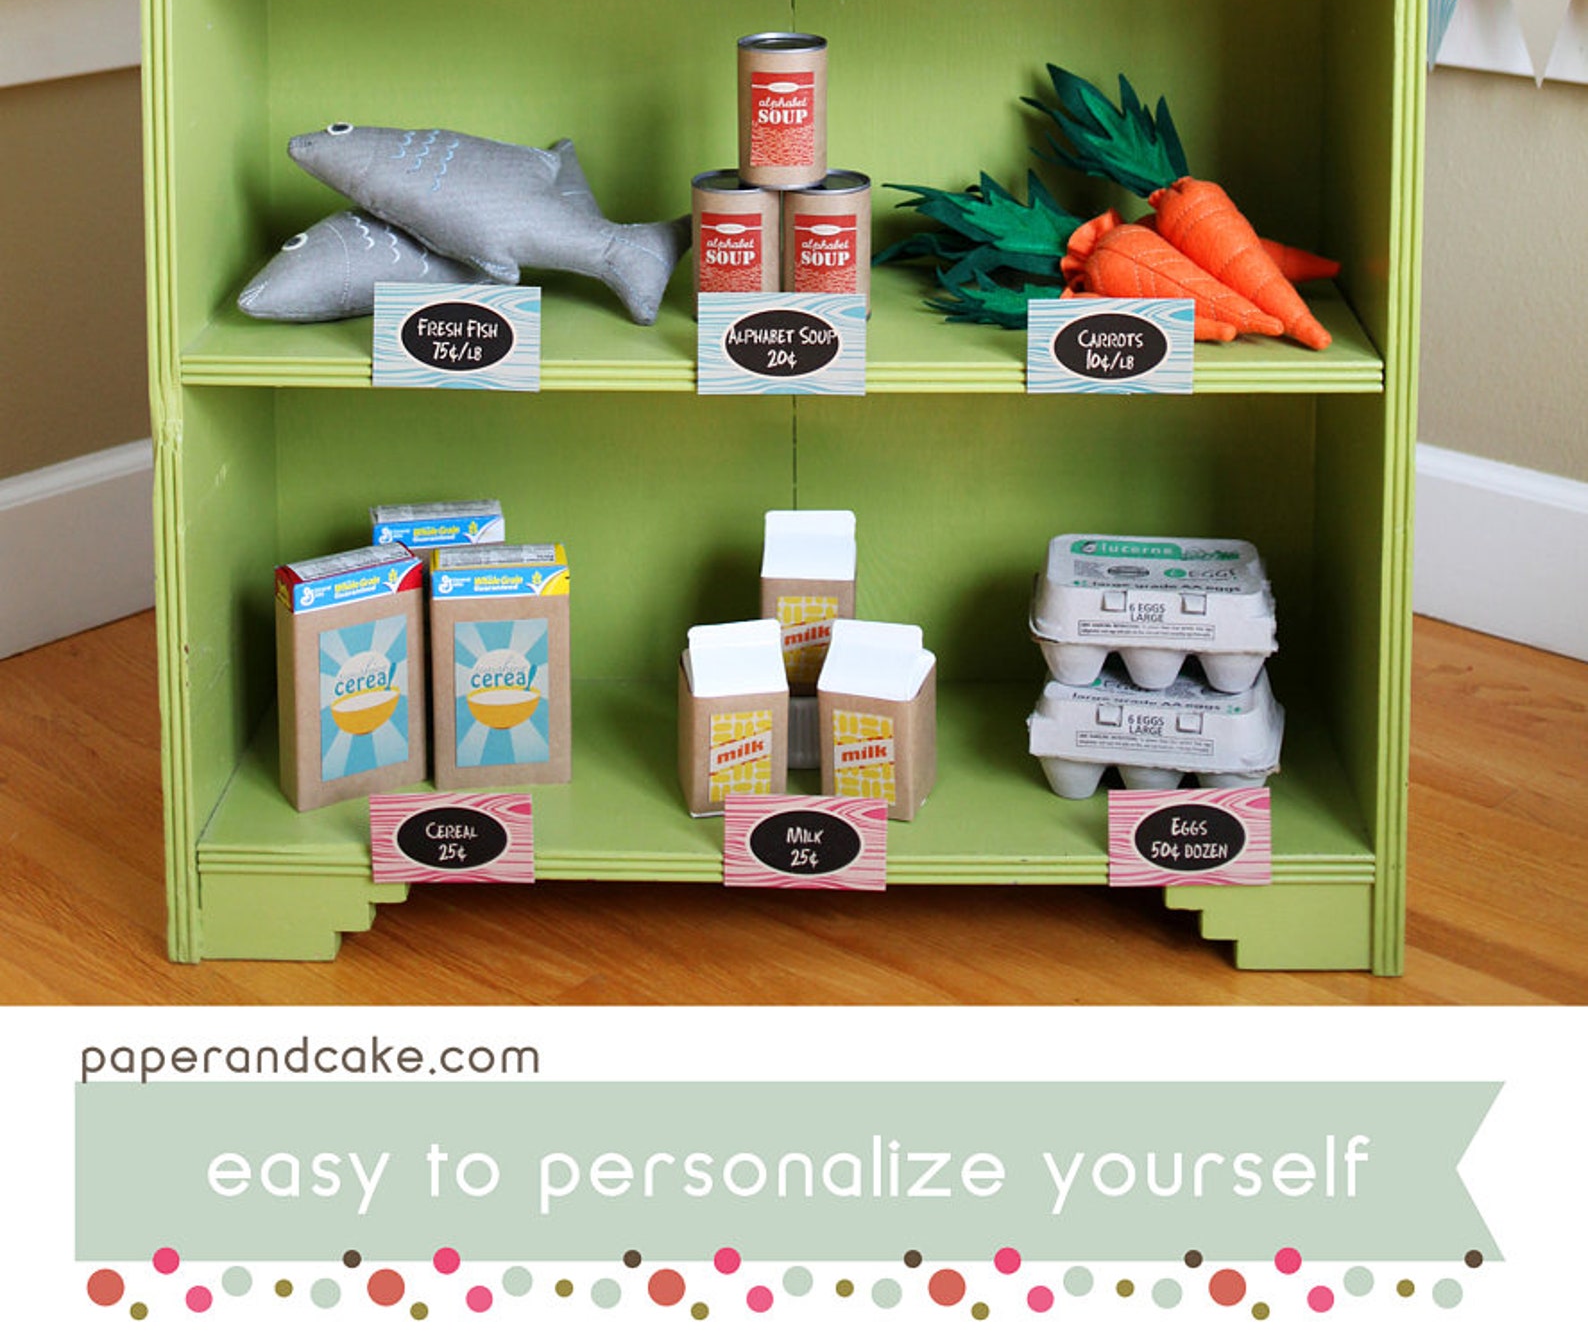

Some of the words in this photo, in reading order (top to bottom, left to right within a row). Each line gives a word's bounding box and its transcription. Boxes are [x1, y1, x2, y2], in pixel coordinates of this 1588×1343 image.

[758, 96, 807, 110] alphabet
[758, 109, 808, 124] SOUP
[706, 238, 754, 252] alphabet
[801, 239, 849, 252] alphabet
[705, 250, 756, 265] SOUP
[801, 251, 850, 266] SOUP
[417, 318, 463, 337] FRESH
[466, 319, 499, 339] FISH
[728, 326, 796, 345] ALPHABET
[799, 325, 838, 345] SOUP
[1077, 329, 1144, 348] CARROTS
[432, 341, 483, 363] 75¢/LB
[767, 349, 797, 369] 20¢
[1086, 349, 1134, 372] 10¢/LB
[1129, 604, 1136, 612] 6
[1138, 604, 1166, 613] EGGS
[1131, 613, 1164, 622] LARGE
[784, 624, 831, 646] milk
[1128, 716, 1135, 725] 6
[1136, 716, 1164, 726] EGGS
[1129, 726, 1163, 736] LARGE
[717, 740, 764, 765] milk
[841, 744, 887, 763] milk
[425, 821, 478, 840] CEREAL
[786, 826, 824, 845] MILK
[1171, 817, 1208, 836] EGGS
[438, 843, 467, 862] 25¢
[790, 848, 819, 869] 25¢
[1151, 841, 1180, 861] 50¢
[1184, 843, 1228, 859] DOZEN
